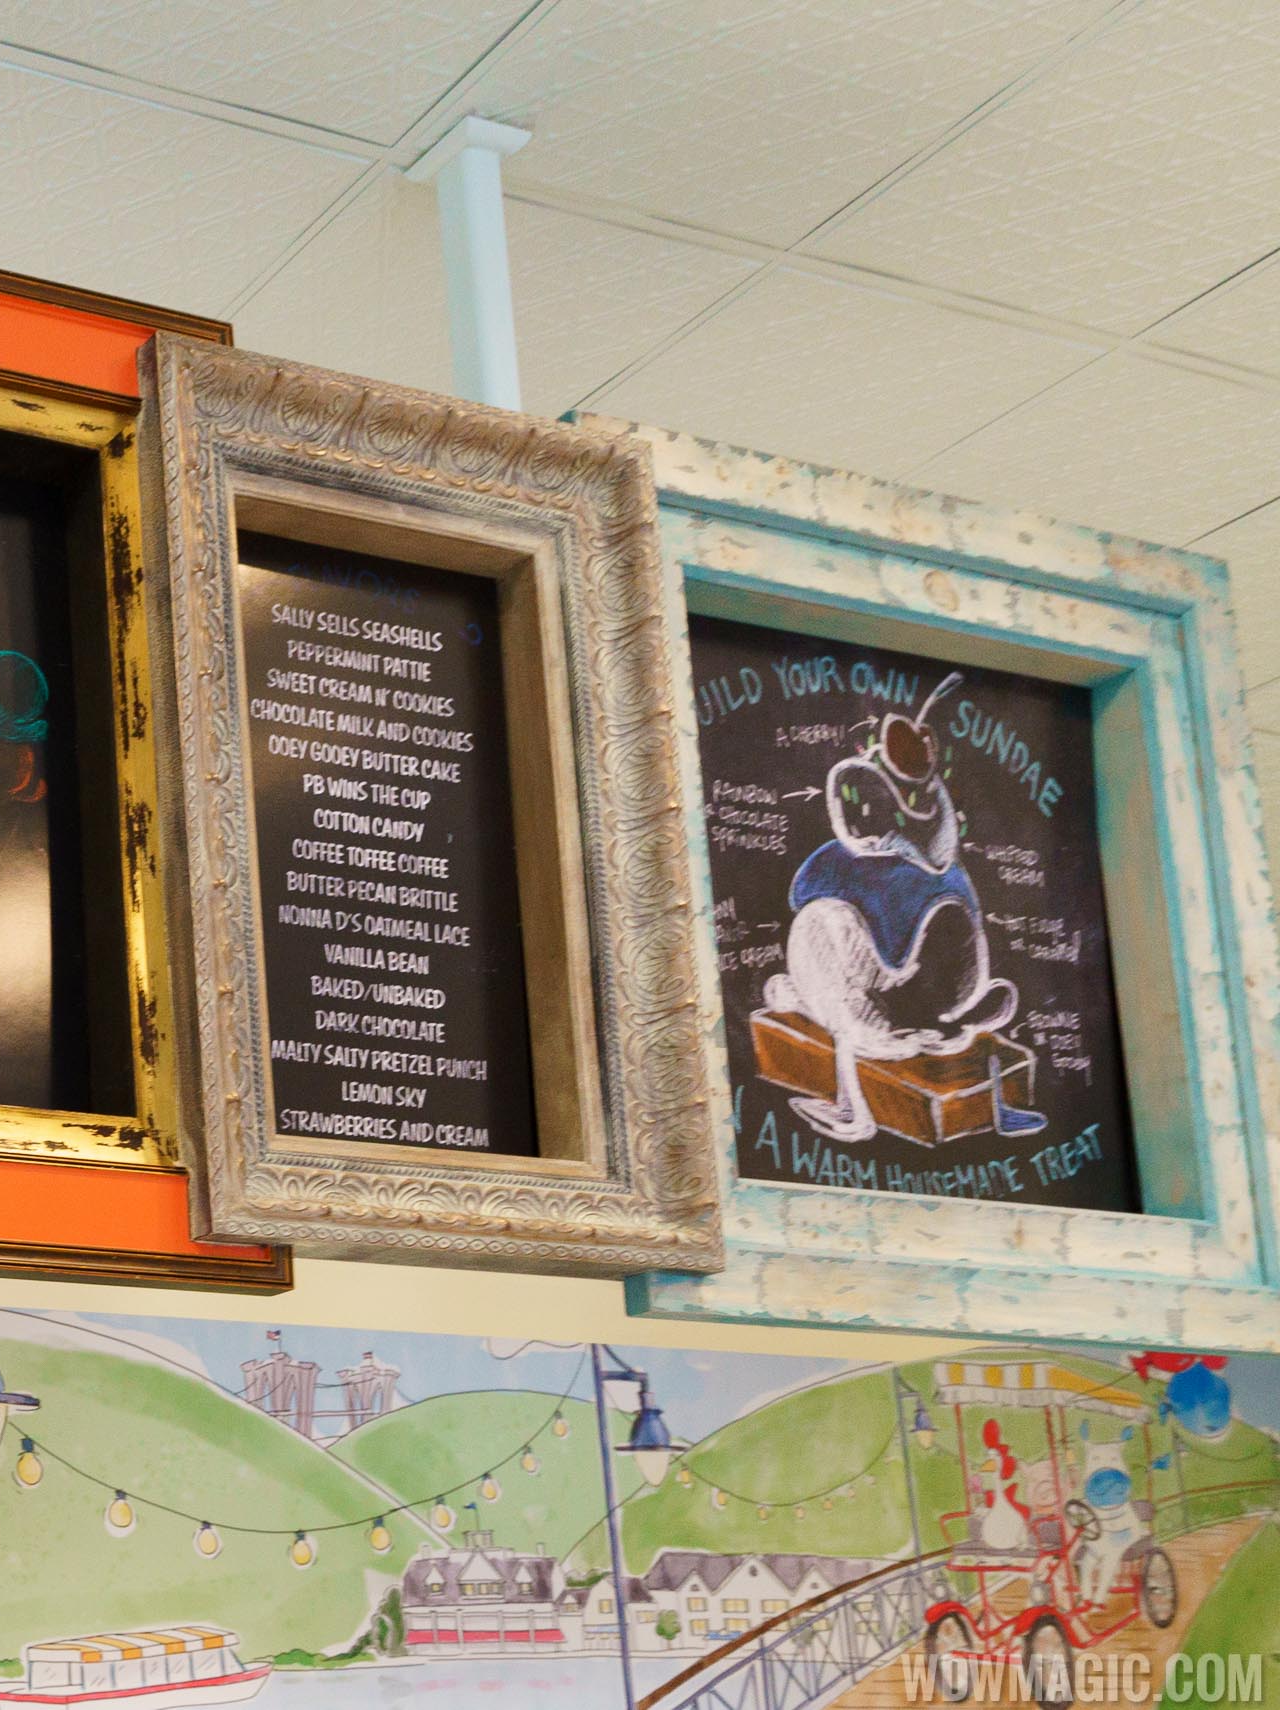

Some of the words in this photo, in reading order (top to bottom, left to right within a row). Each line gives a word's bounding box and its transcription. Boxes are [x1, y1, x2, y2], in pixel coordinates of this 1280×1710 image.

[271, 603, 315, 629] SALLY
[317, 612, 360, 637] SELLS
[362, 620, 443, 652] SEASHELLS
[287, 640, 381, 673] PEPPERMINT
[383, 657, 432, 683] PATTIE
[267, 668, 317, 695] SWEET
[319, 677, 372, 705] CREAM
[393, 691, 455, 717] COOKIES
[250, 698, 335, 731] CHOCOLATE
[337, 714, 375, 737] MILK
[376, 721, 410, 743] AND
[412, 725, 474, 752] COOKIES
[699, 667, 762, 726] UILD
[771, 655, 847, 700] YOUR
[850, 661, 919, 707] OWN
[949, 699, 1064, 817] SUNDAE
[268, 735, 308, 759] OOEY
[309, 741, 360, 768] GOOEY
[362, 749, 420, 777] BUTTER
[421, 759, 462, 783] CAKE
[303, 773, 325, 795] PB
[327, 776, 368, 801] WINS
[371, 783, 399, 806] THE
[400, 788, 431, 811] CUP
[313, 808, 370, 835] COTTON
[372, 816, 425, 843] CANDY
[292, 838, 344, 864] COFFEE
[346, 846, 396, 871] TOFFEE
[397, 853, 449, 878] COFFEE
[286, 870, 346, 898] BUTTER
[347, 880, 397, 905] PECAN
[399, 886, 459, 912] BRITTLE
[278, 905, 334, 930] NONNA
[335, 911, 362, 933] D'S
[364, 916, 432, 942] OATMEAL
[434, 924, 471, 947] LACE
[324, 944, 386, 970] VANILLA
[387, 951, 429, 975] BEAN
[310, 975, 446, 1010] BAKED/UNBAKED
[315, 1010, 360, 1034] DARK
[361, 1017, 446, 1044] CHOCOLATE
[271, 1040, 322, 1061] MALTY
[323, 1044, 370, 1068] SALTY
[371, 1051, 436, 1075] PRETZEL
[436, 1057, 488, 1081] PUNCH
[341, 1081, 394, 1104] LEMON
[395, 1086, 427, 1109] SKY
[280, 1109, 397, 1140] STRAWBERRIES
[399, 1120, 434, 1143] AND
[435, 1125, 490, 1147] CREAM
[754, 1111, 781, 1169] A
[791, 1132, 878, 1190] WARM
[1030, 1123, 1104, 1186] TREAT
